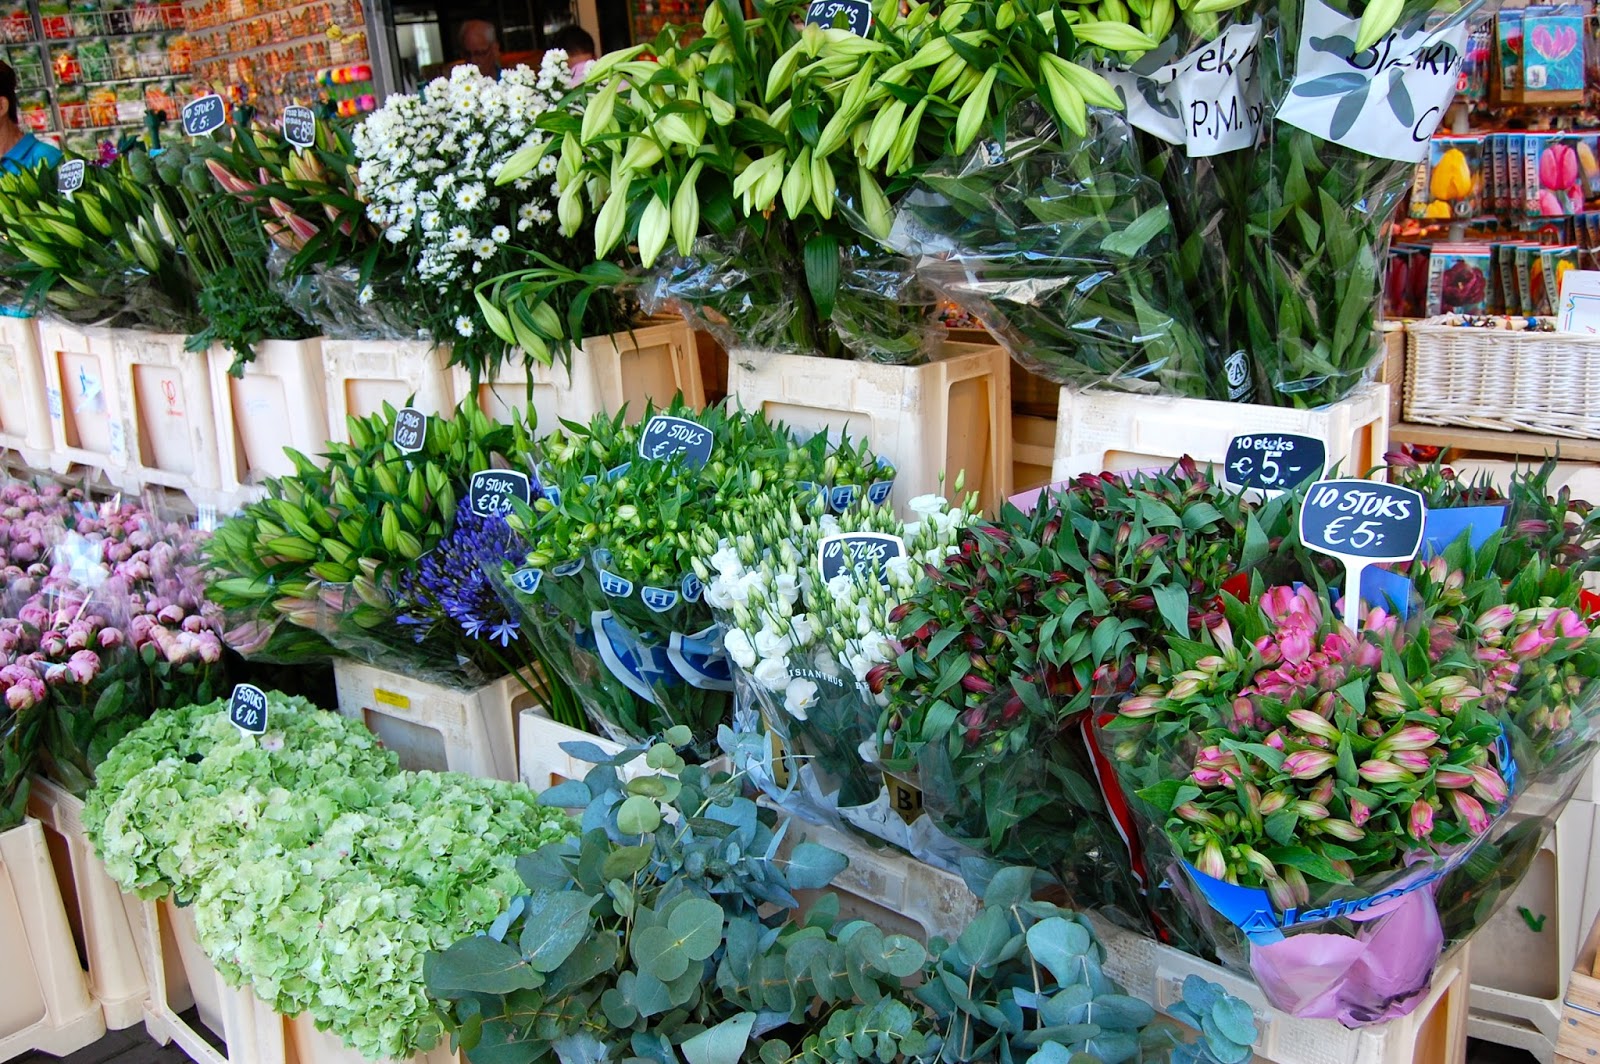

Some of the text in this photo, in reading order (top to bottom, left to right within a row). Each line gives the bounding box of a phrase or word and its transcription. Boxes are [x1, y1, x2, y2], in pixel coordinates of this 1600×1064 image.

[811, 3, 825, 17] 10
[184, 108, 193, 119] 10
[650, 421, 704, 445] 10 STUKS
[1236, 437, 1252, 449] 10
[475, 477, 514, 494] 10 STUKS
[1312, 486, 1411, 520] 10 STUKS
[825, 542, 841, 558] 10
